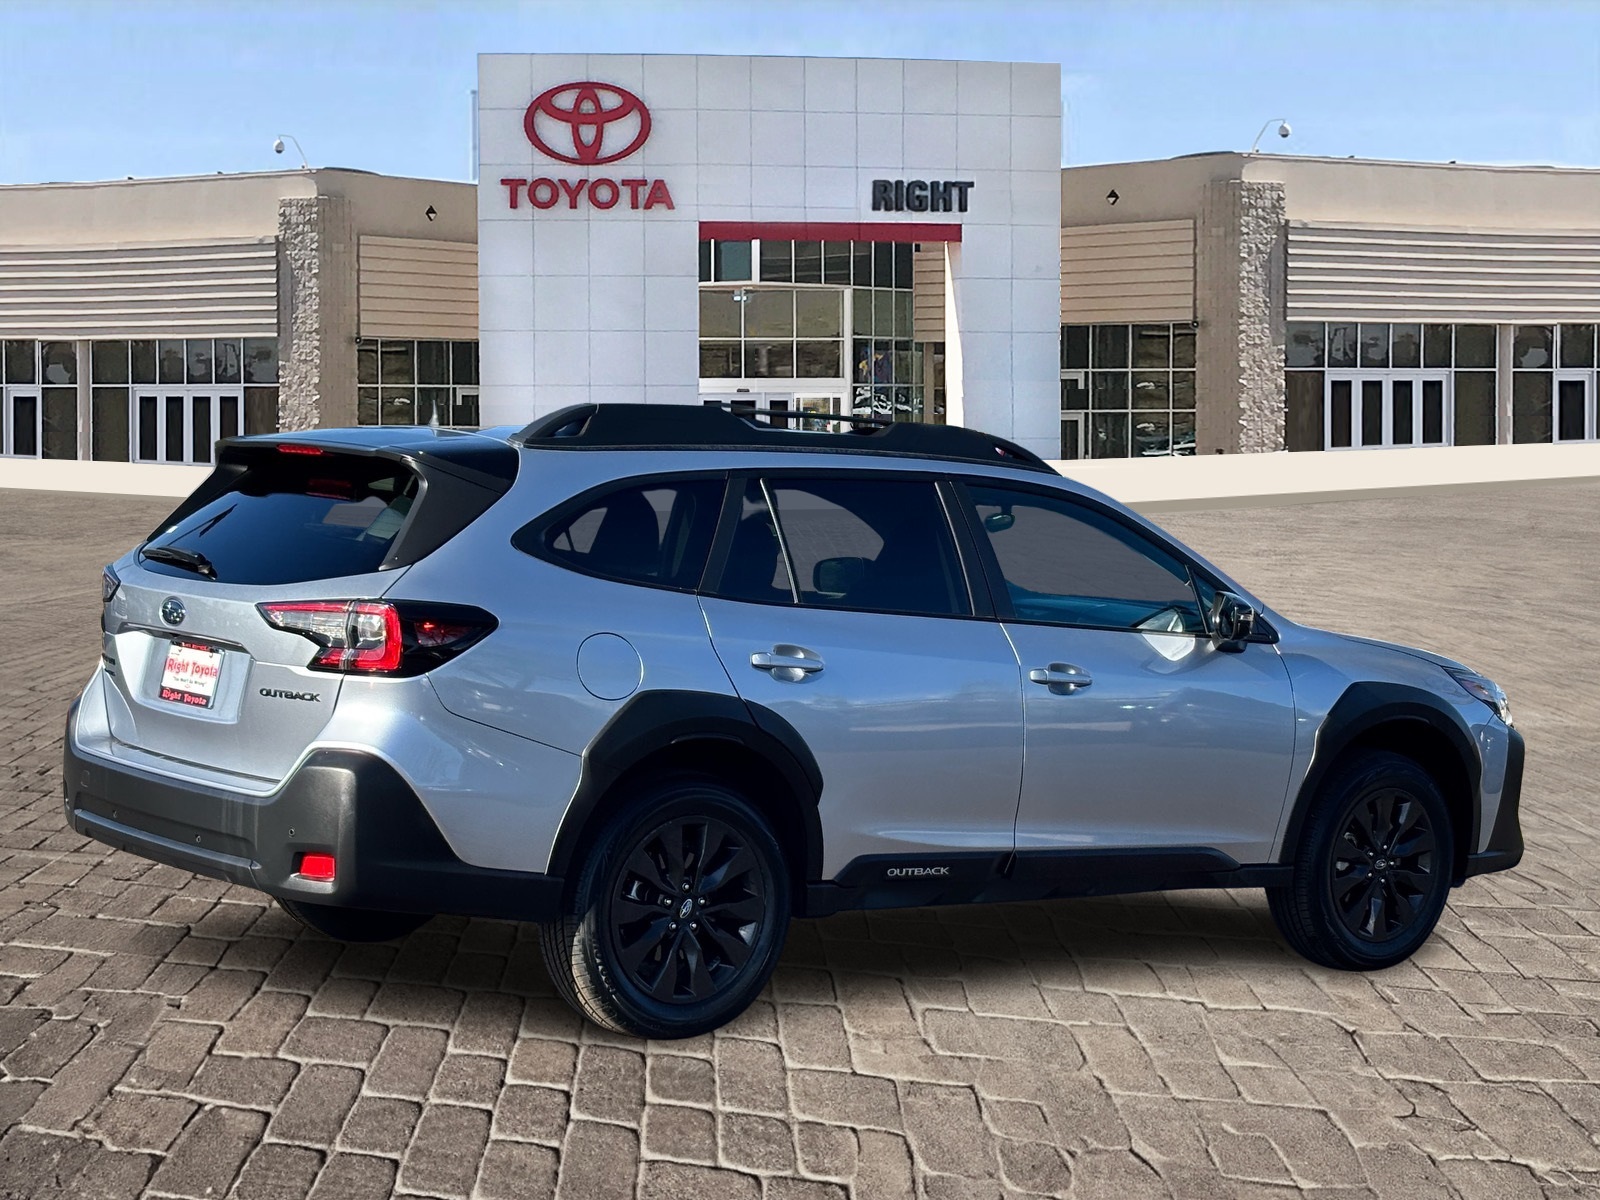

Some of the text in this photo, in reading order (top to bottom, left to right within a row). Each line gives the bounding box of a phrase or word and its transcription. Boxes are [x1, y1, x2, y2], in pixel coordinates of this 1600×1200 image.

[500, 177, 675, 210] TOYOTA
[872, 179, 975, 212] RIGHT
[167, 658, 218, 678] Right Toyota
[162, 687, 207, 705] Right Toyota
[259, 688, 321, 702] OUTBACK
[887, 867, 949, 876] OUTBACK
